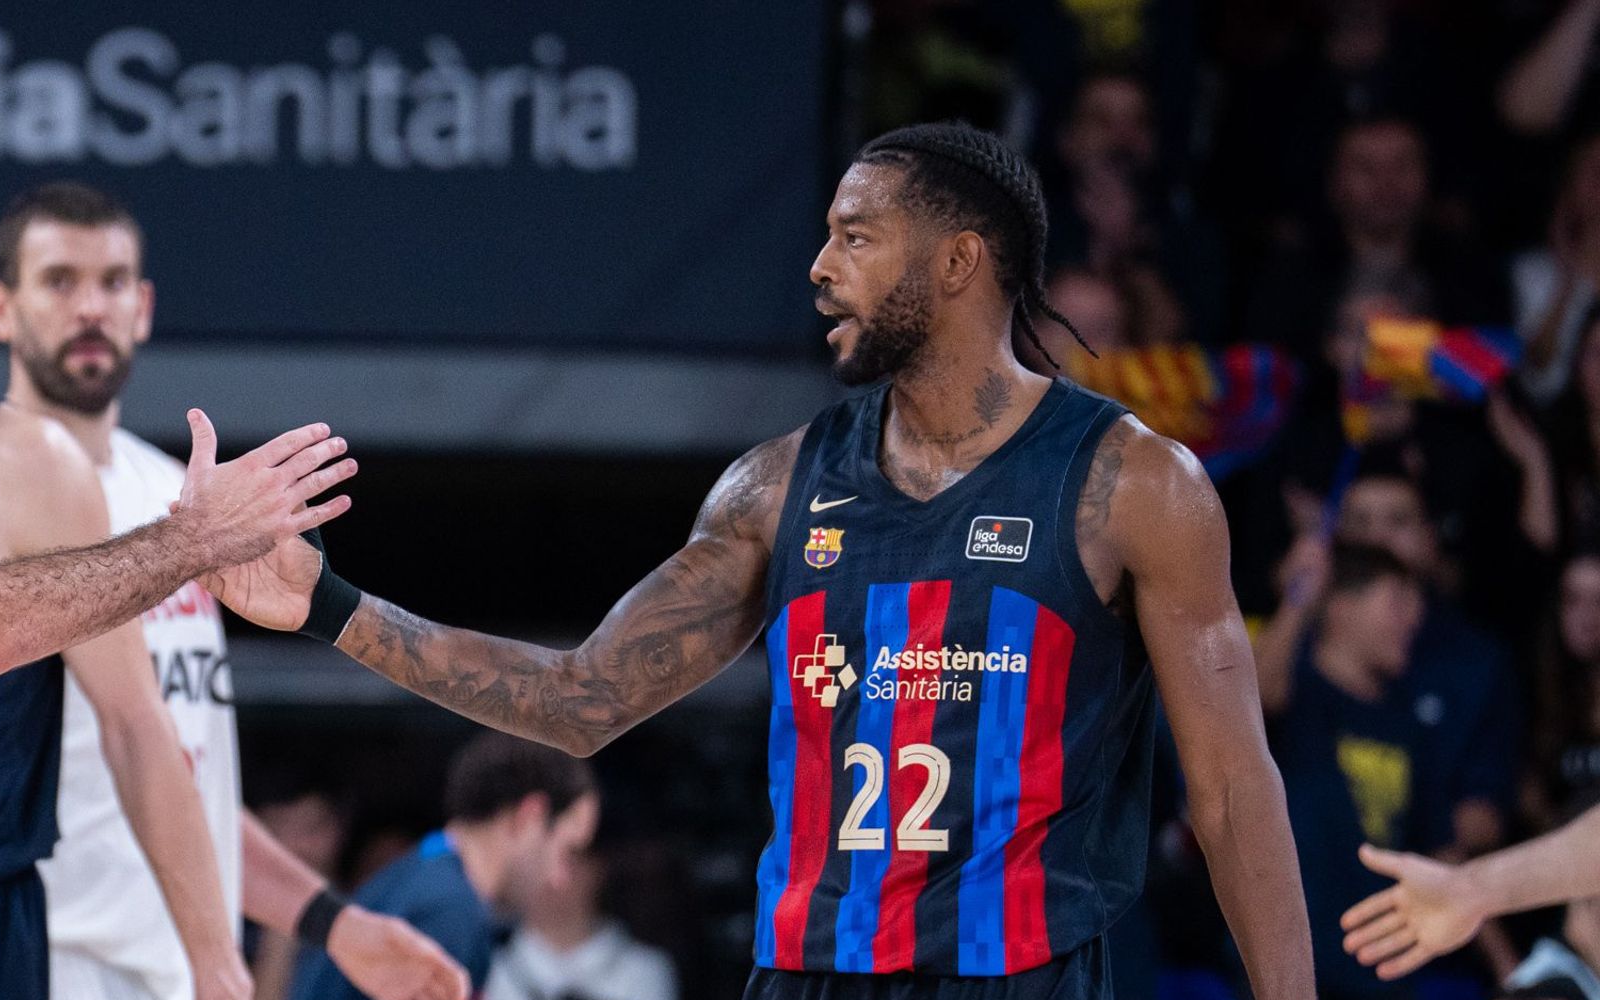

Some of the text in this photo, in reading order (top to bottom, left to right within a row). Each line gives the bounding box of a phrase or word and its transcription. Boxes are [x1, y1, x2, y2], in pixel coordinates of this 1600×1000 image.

[972, 541, 1023, 555] endesa
[975, 529, 998, 543] liga
[872, 643, 1027, 673] Assistència
[866, 674, 973, 701] Sanitària
[838, 743, 951, 851] 22
